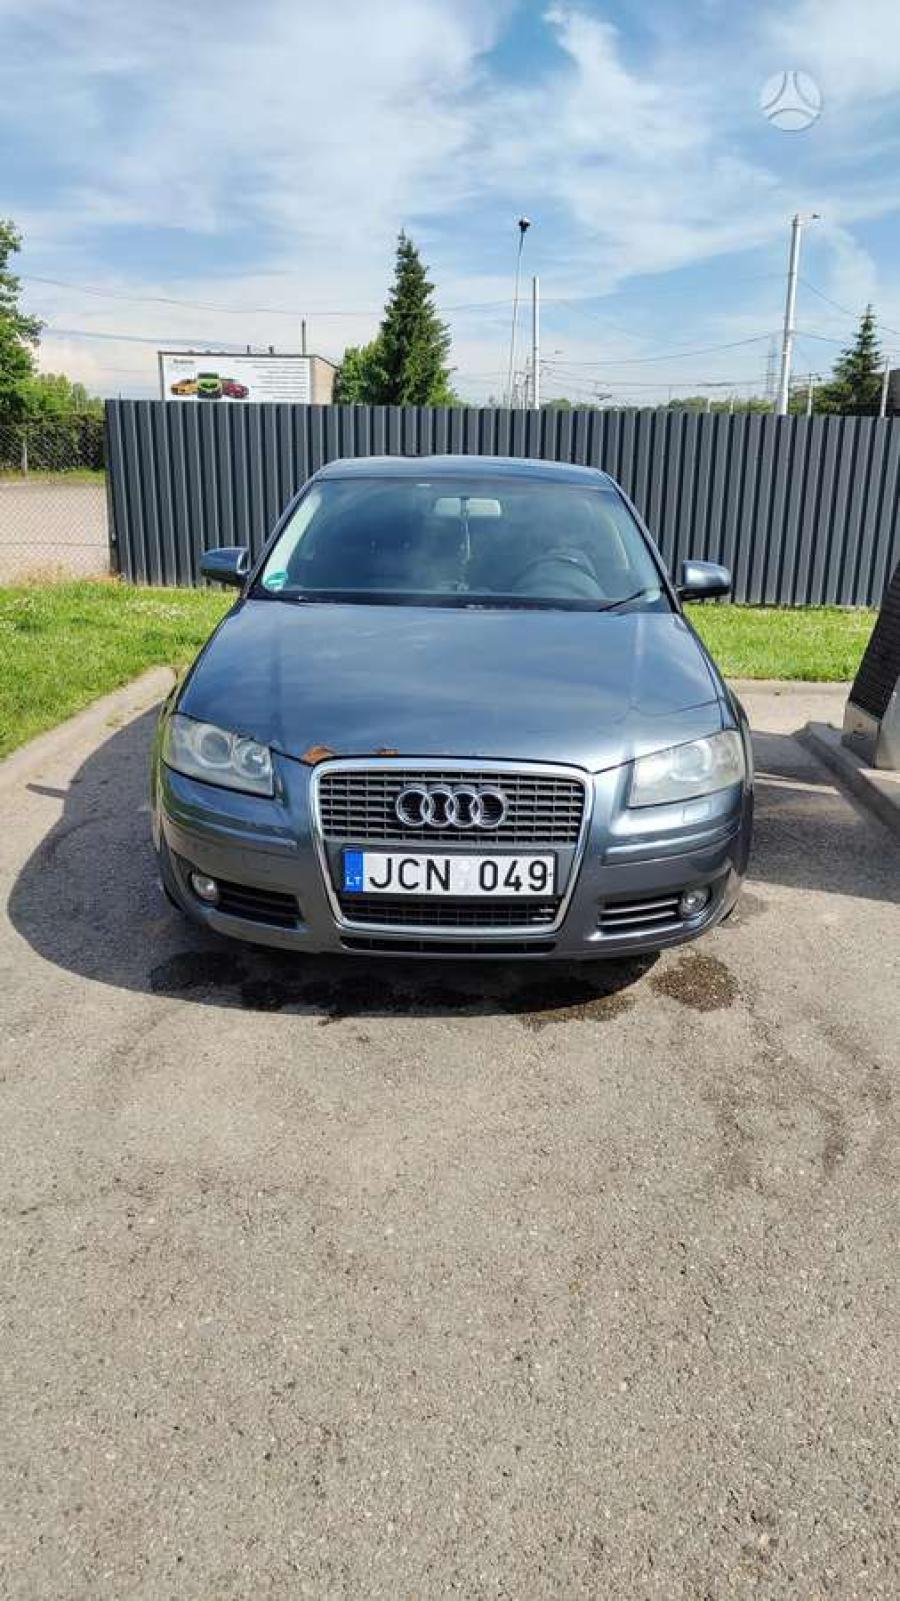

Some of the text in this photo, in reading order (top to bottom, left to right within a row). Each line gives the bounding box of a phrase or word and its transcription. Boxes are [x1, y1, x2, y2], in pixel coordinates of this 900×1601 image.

[346, 876, 361, 886] LT
[369, 858, 548, 892] JCN 049
